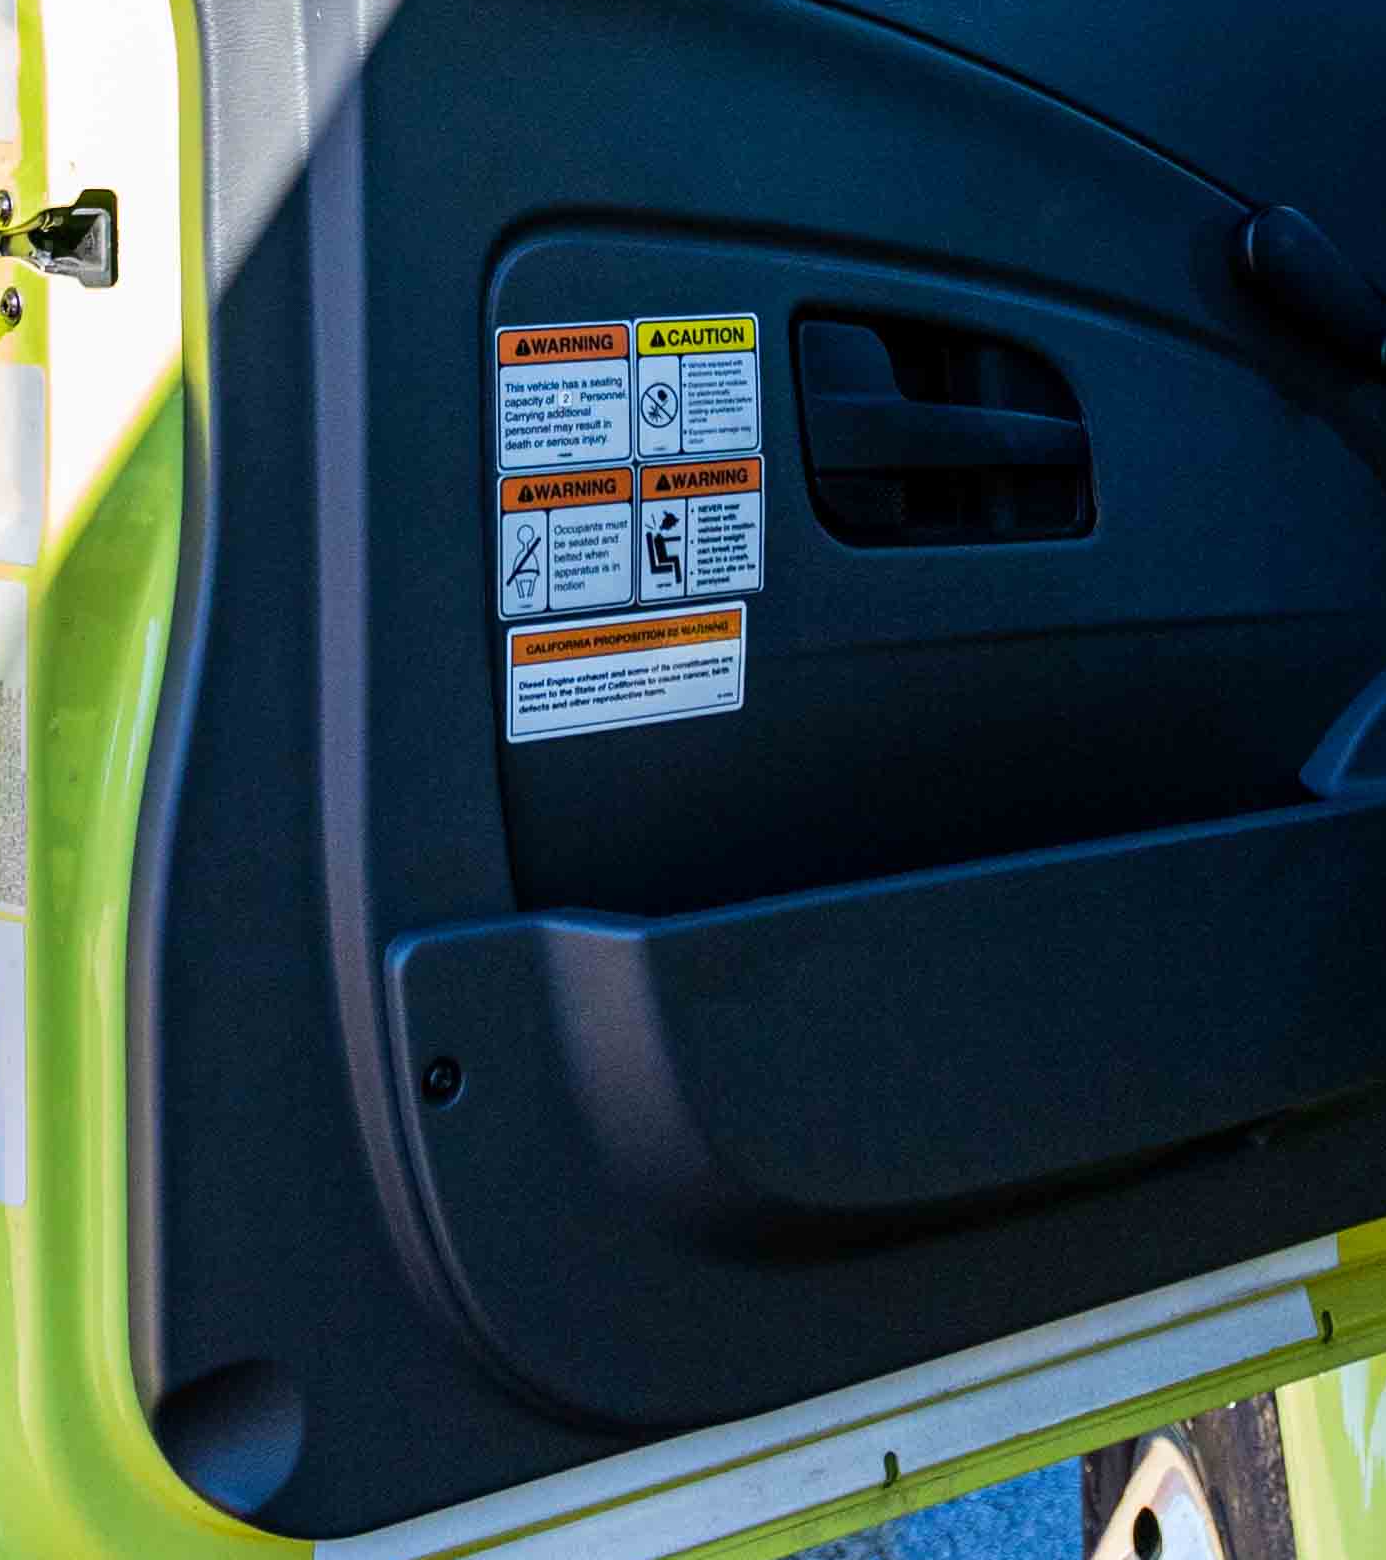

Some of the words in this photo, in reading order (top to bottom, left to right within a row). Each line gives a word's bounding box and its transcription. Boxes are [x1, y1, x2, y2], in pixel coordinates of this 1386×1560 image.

[532, 333, 614, 355] WARNING
[667, 326, 745, 347] CAUTION
[505, 383, 525, 393] This
[527, 381, 560, 392] vehicle
[562, 379, 580, 390] has
[590, 376, 623, 388] seating
[504, 396, 543, 409] capacity
[545, 394, 555, 405] of
[505, 411, 545, 423] Carrying
[547, 407, 591, 418] additional
[505, 424, 552, 438] personnel
[553, 424, 573, 434] may
[575, 420, 601, 430] result
[603, 419, 612, 429] in
[505, 439, 532, 451] death
[534, 440, 545, 449] or
[546, 437, 580, 447] serious
[672, 467, 749, 489] WARNING
[534, 478, 617, 501] WARNING
[697, 504, 722, 513] NEVER
[554, 521, 603, 536] Occupants
[605, 520, 628, 530] must
[554, 538, 566, 549] be
[568, 536, 599, 547] seated
[601, 535, 619, 545] and
[554, 552, 582, 563] belted
[585, 550, 610, 561] when
[554, 565, 600, 579] apparatus
[612, 562, 621, 572] in
[525, 638, 591, 656] CALIFORNIA
[593, 629, 664, 649] PROPOSITION
[680, 620, 730, 636] WARNING
[518, 679, 545, 691] Diesel
[547, 675, 575, 689] Engine
[577, 671, 609, 683] exhaust
[611, 669, 626, 680] and
[628, 666, 650, 677] some
[518, 690, 547, 702] known
[548, 689, 558, 698] to
[559, 687, 573, 697] the
[575, 684, 596, 695] State
[597, 682, 607, 692] of
[608, 678, 647, 691] California
[518, 702, 550, 715] defects
[551, 699, 567, 711] and
[569, 696, 590, 708] other
[592, 691, 643, 706] reproductive
